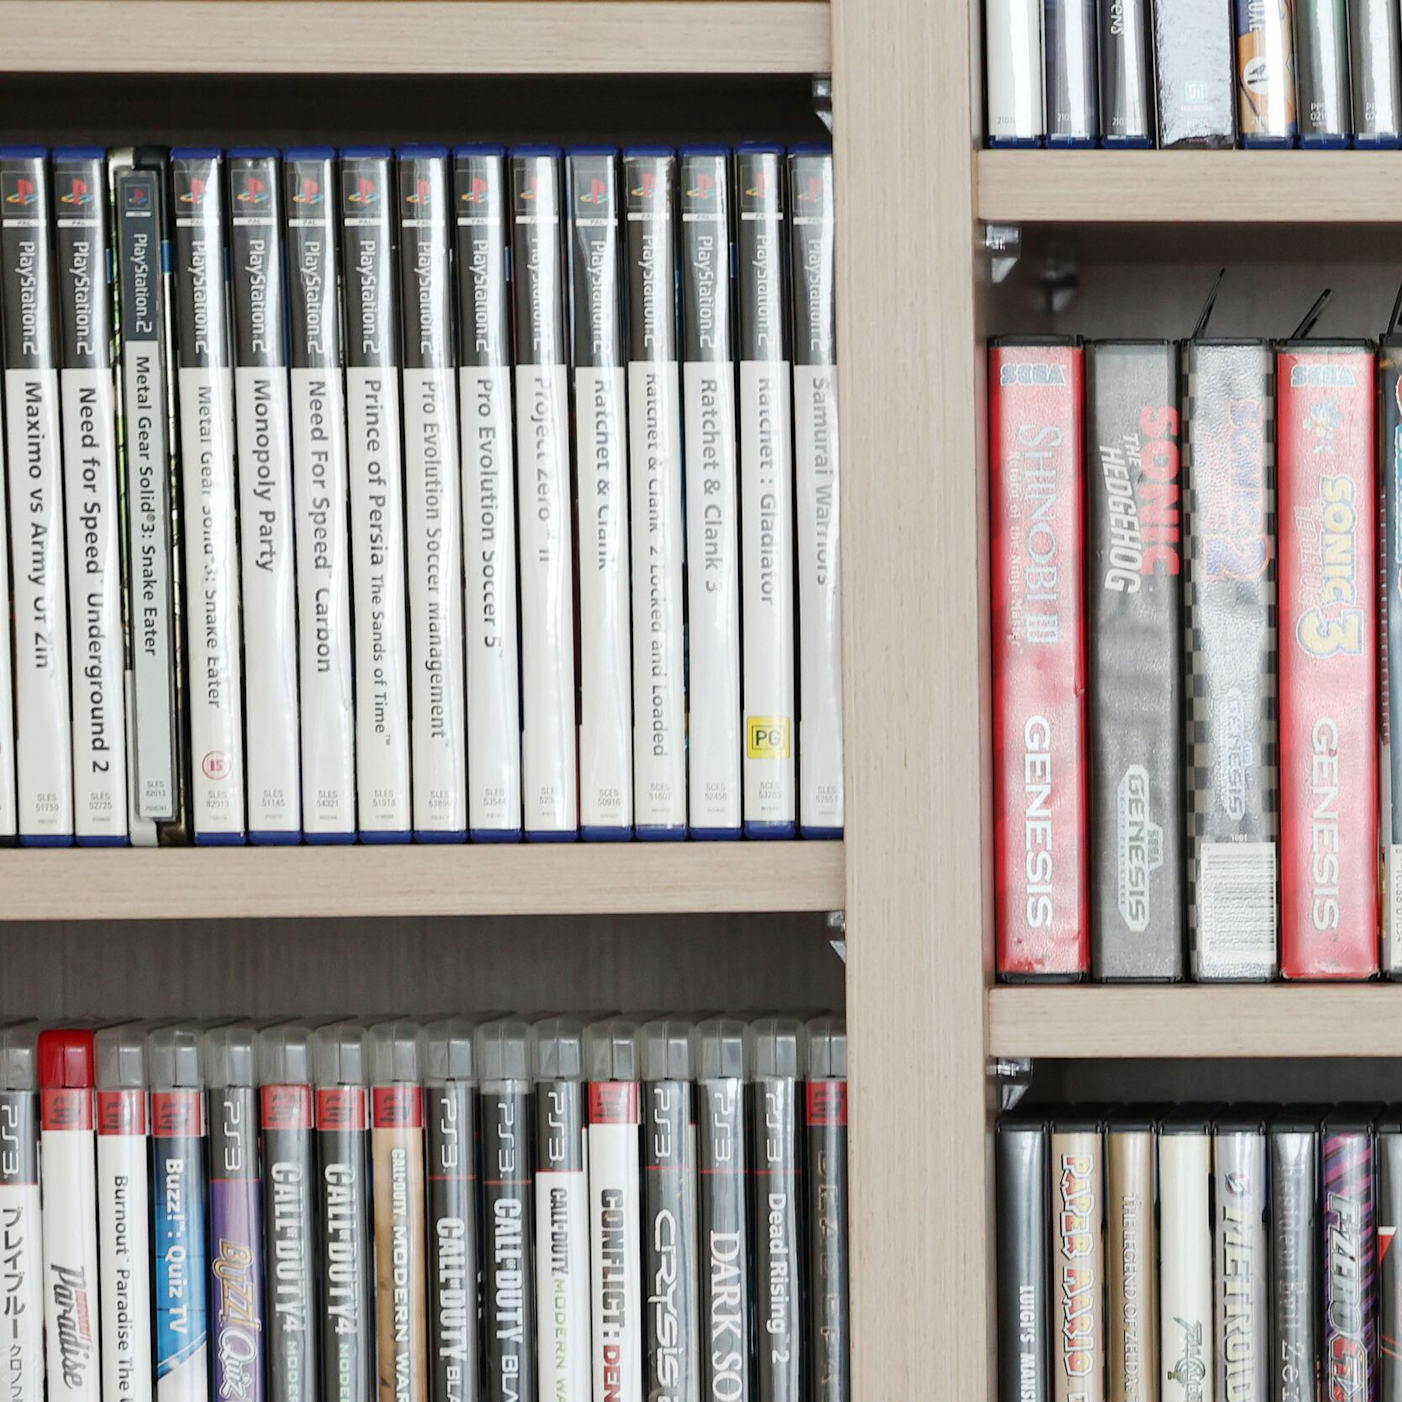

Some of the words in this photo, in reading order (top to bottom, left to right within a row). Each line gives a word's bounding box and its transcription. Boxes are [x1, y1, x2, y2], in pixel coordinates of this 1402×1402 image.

[136, 356, 155, 411] Metal
[78, 387, 99, 447] Need
[138, 416, 155, 460] Gear
[247, 380, 276, 502] Monopoly
[364, 379, 385, 453] Prince
[81, 457, 101, 493] for
[366, 462, 387, 487] of
[1122, 433, 1142, 468] THE
[1099, 444, 1141, 594] HEDGEHOG
[1141, 405, 1179, 576] SONIC
[251, 510, 278, 572] Party
[368, 494, 389, 566] Persia
[141, 545, 158, 601] Snake
[371, 575, 386, 605] The
[143, 608, 159, 656] Eater
[372, 610, 388, 661] Sands
[82, 592, 108, 750] Underground
[373, 667, 389, 686] of
[91, 757, 110, 773] 2
[1024, 715, 1052, 928] GENESIS
[1311, 717, 1338, 931] GENESIS
[768, 1193, 788, 1254] Dead
[1061, 1155, 1093, 1259] PAPER
[163, 1245, 186, 1299] Quiz
[600, 1188, 626, 1338] CONFLICT:
[710, 1230, 742, 1338] DARK
[114, 1269, 132, 1351] Paradise
[168, 1305, 187, 1334] TV
[765, 1260, 789, 1334] Rising
[1020, 1286, 1035, 1342] LUIGI'S
[1061, 1267, 1094, 1378] MARIO
[118, 1357, 134, 1392] The
[771, 1350, 790, 1363] 2
